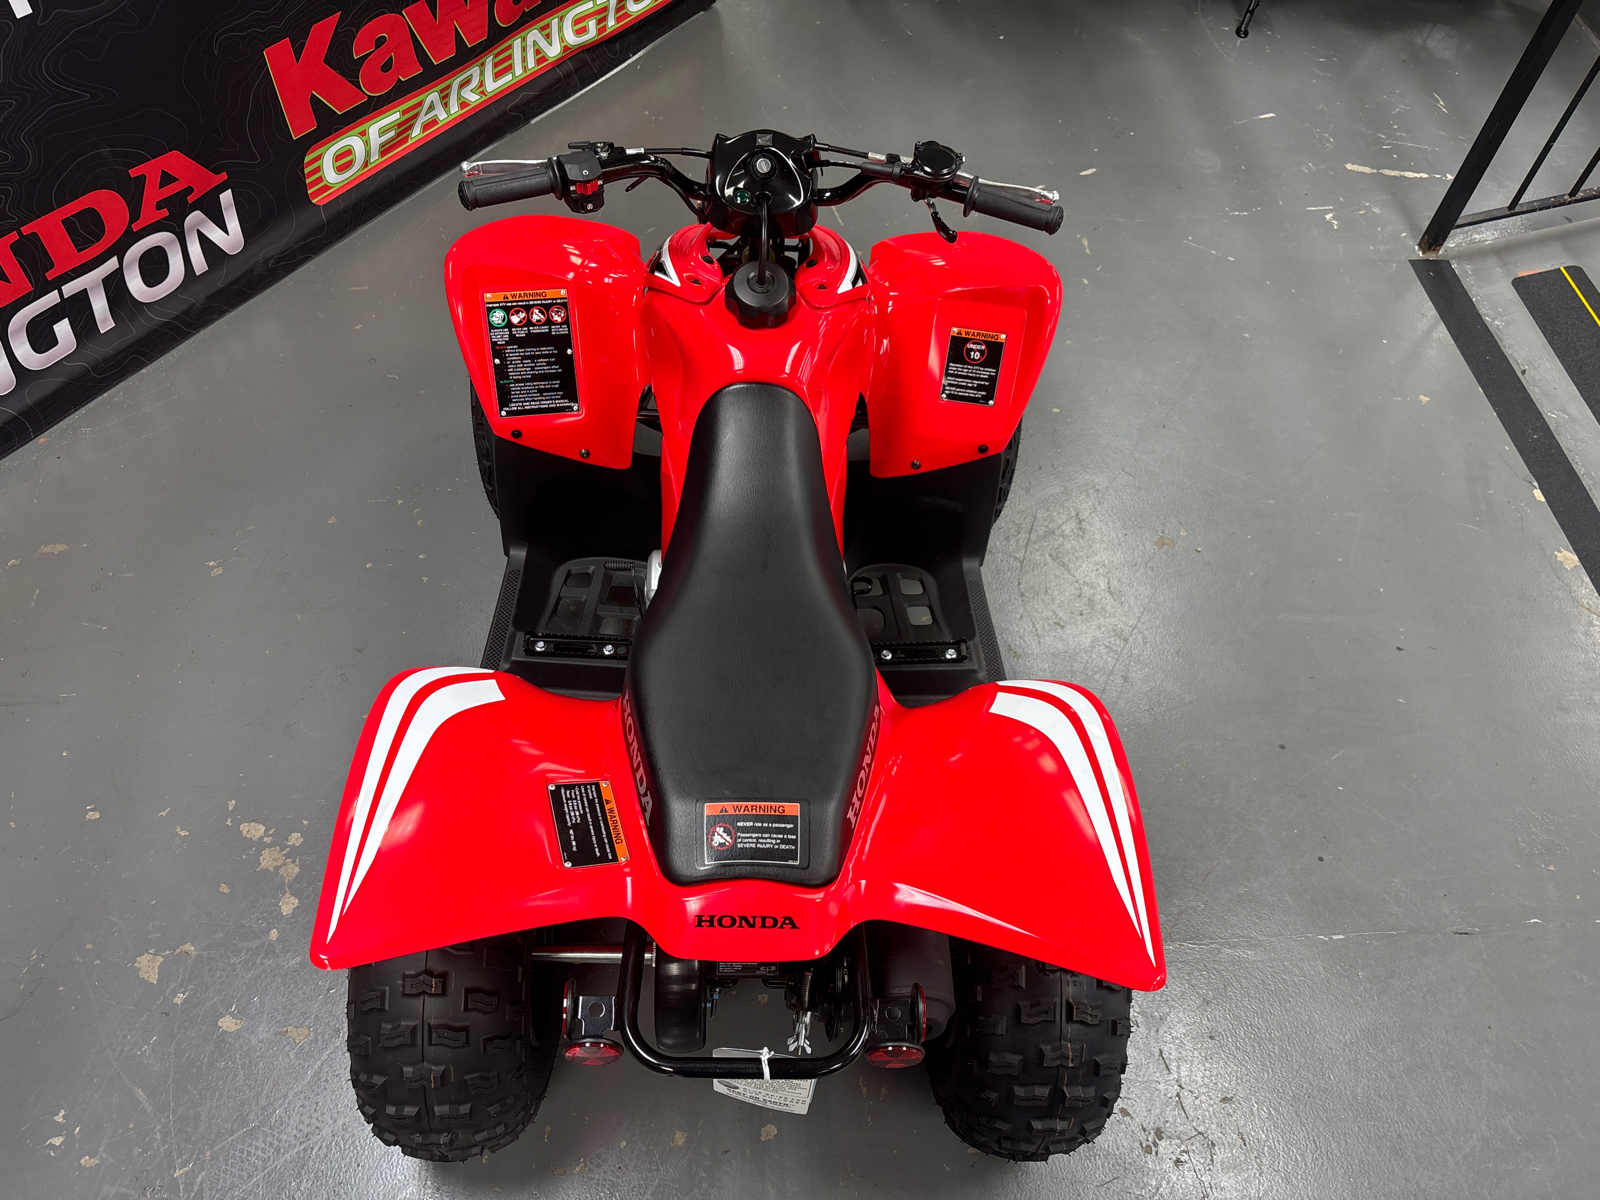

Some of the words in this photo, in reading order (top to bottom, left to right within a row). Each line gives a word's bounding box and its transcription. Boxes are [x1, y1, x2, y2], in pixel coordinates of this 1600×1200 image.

[322, 112, 401, 186] OF
[511, 291, 547, 299] WARNING
[964, 330, 999, 340] WARNING
[969, 351, 980, 359] 10
[623, 689, 652, 826] HONDA
[847, 705, 880, 829] HONDA
[733, 805, 785, 813] WARNING
[607, 808, 623, 844] WARNING
[694, 914, 800, 929] HONDA
